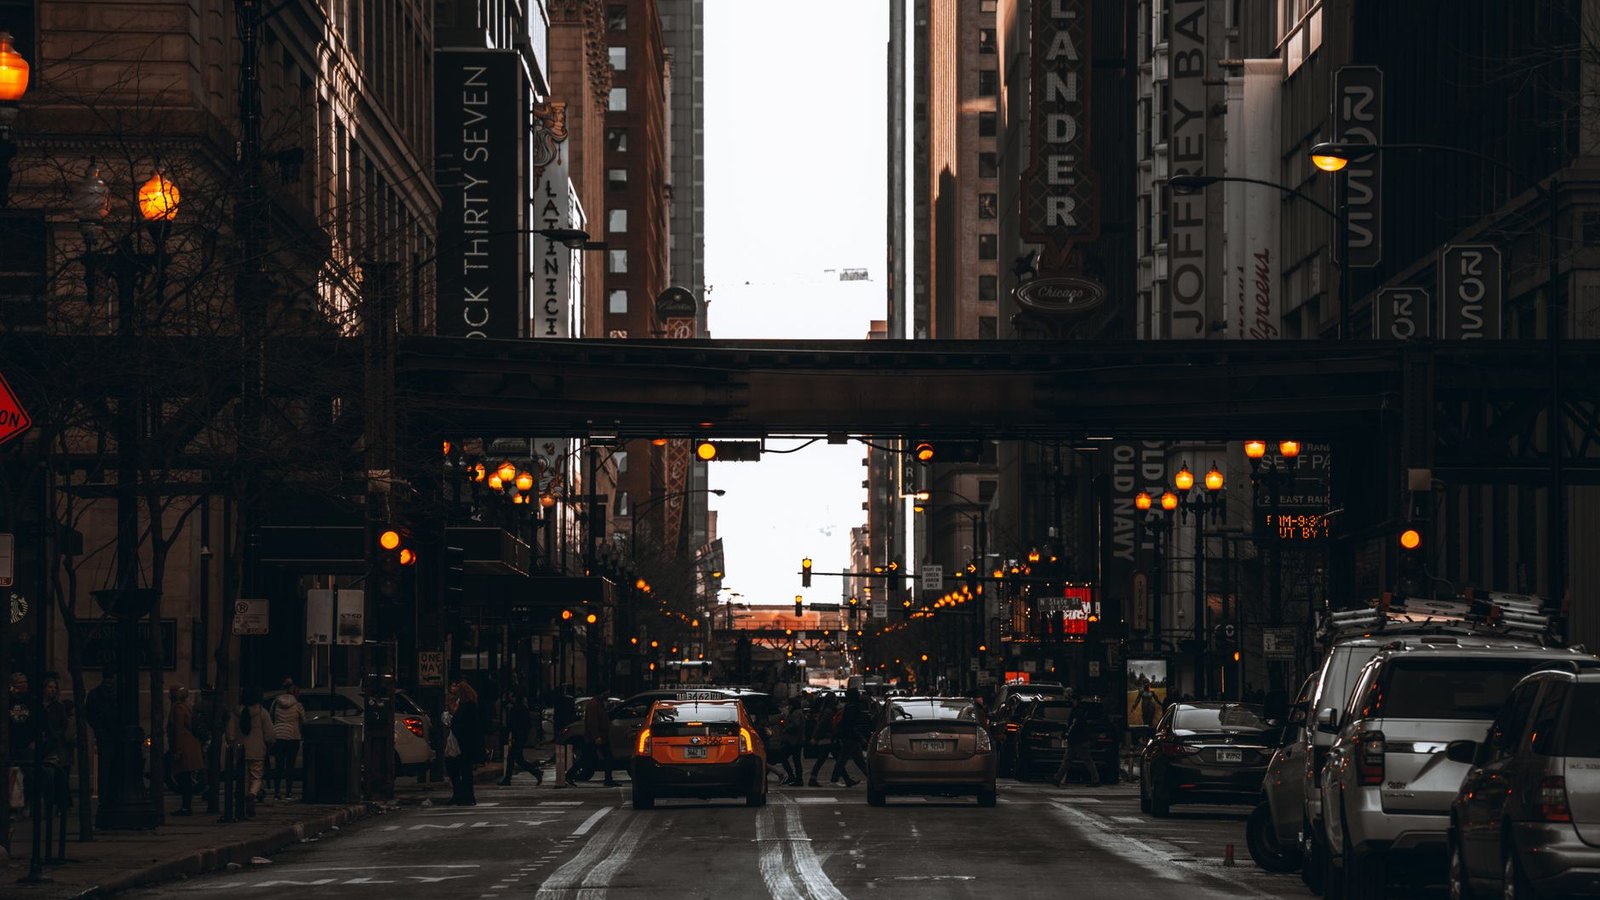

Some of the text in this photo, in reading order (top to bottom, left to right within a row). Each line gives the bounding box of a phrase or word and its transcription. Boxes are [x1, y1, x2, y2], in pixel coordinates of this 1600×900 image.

[1173, 0, 1205, 78] BA
[463, 66, 489, 162] SEVEN
[463, 175, 489, 275] THIRTY
[1037, 285, 1084, 303] Chicago
[1459, 251, 1486, 339] ROS
[1261, 454, 1308, 470] SEF
[1113, 445, 1135, 563] OLD NAVY
[1264, 495, 1271, 504] 2
[1280, 495, 1305, 504] EAST
[1302, 527, 1318, 539] BY
[421, 653, 441, 663] ONE
[421, 663, 441, 672] WAY
[687, 692, 710, 700] 3662
